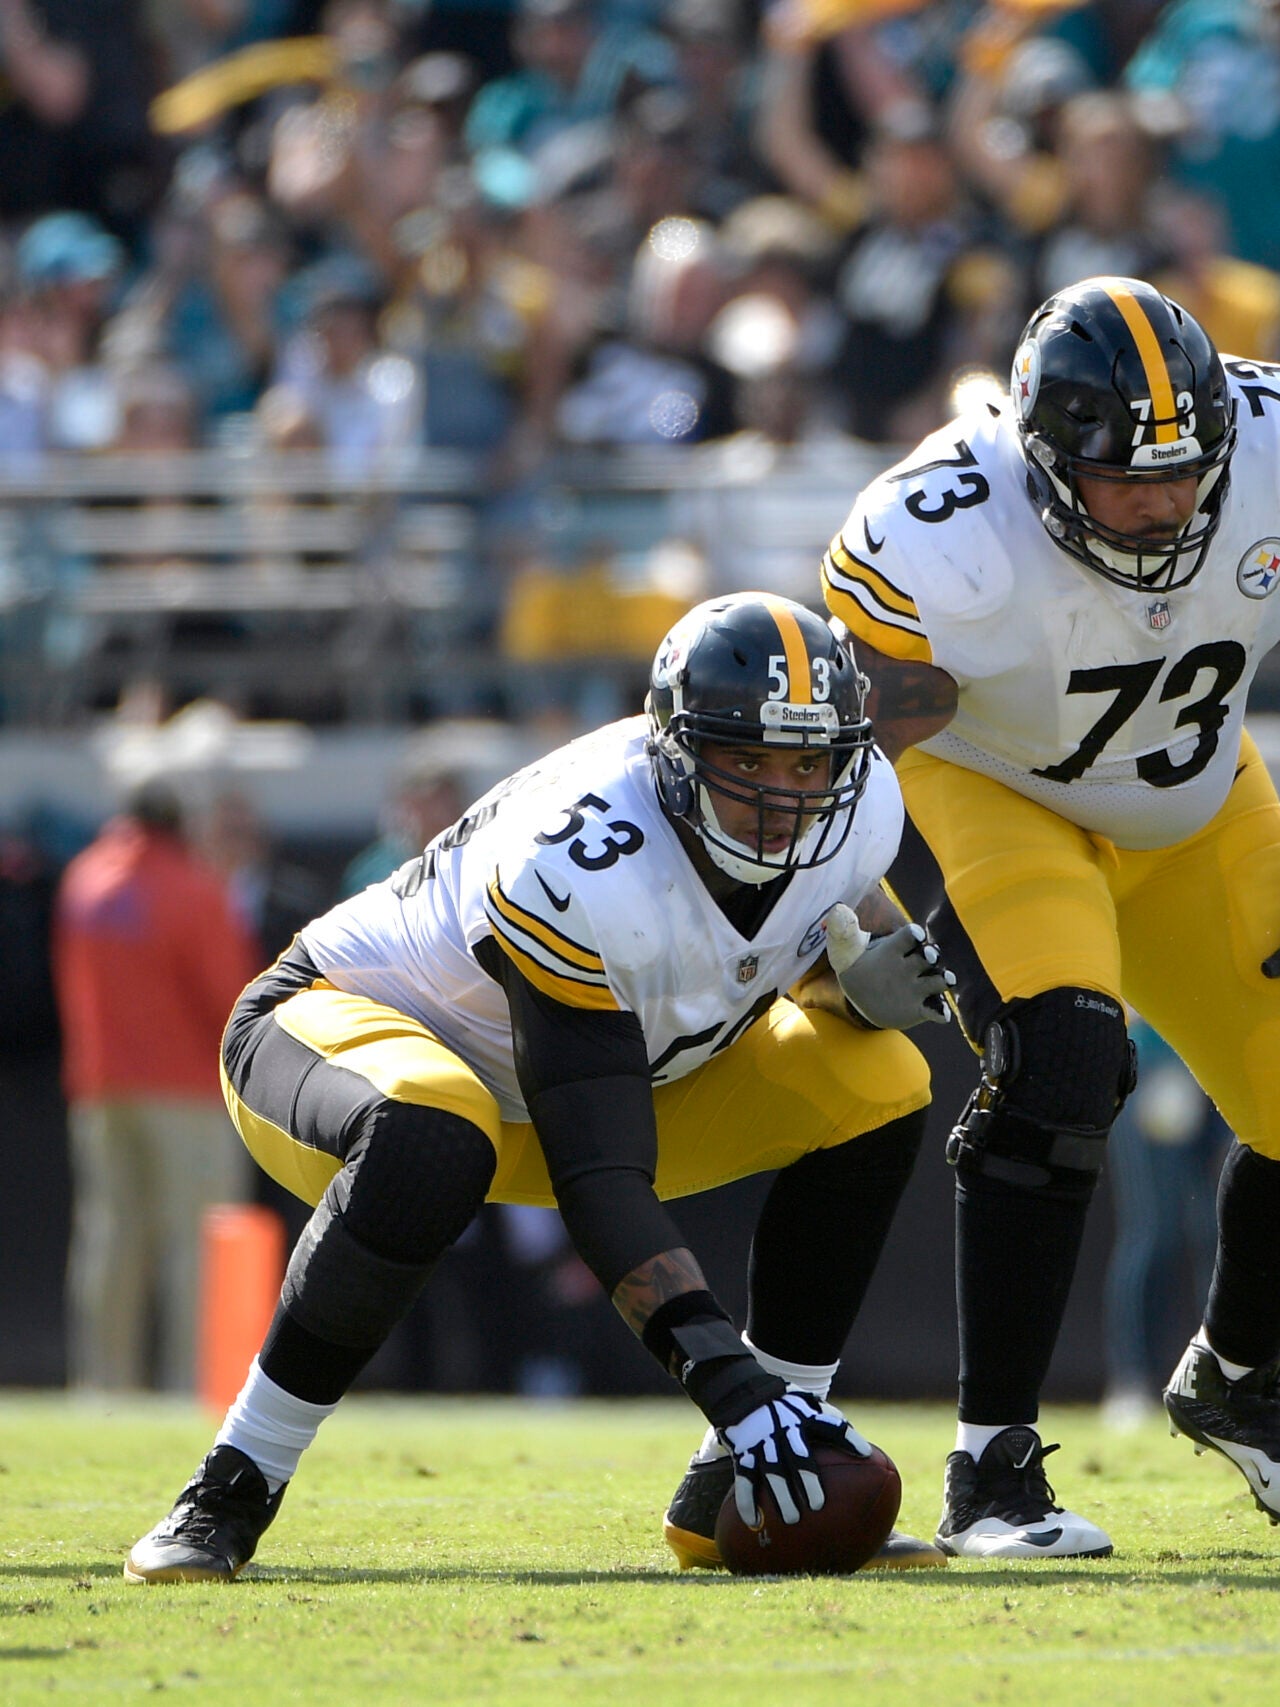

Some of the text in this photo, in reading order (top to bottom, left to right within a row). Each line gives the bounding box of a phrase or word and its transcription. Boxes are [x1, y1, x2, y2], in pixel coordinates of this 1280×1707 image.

[1130, 391, 1197, 447] 73
[887, 438, 990, 524] 73
[1151, 446, 1187, 460] Steelers
[768, 655, 830, 702] 53
[782, 707, 820, 722] Steelers
[1030, 640, 1246, 788] 73
[533, 792, 645, 871] 53
